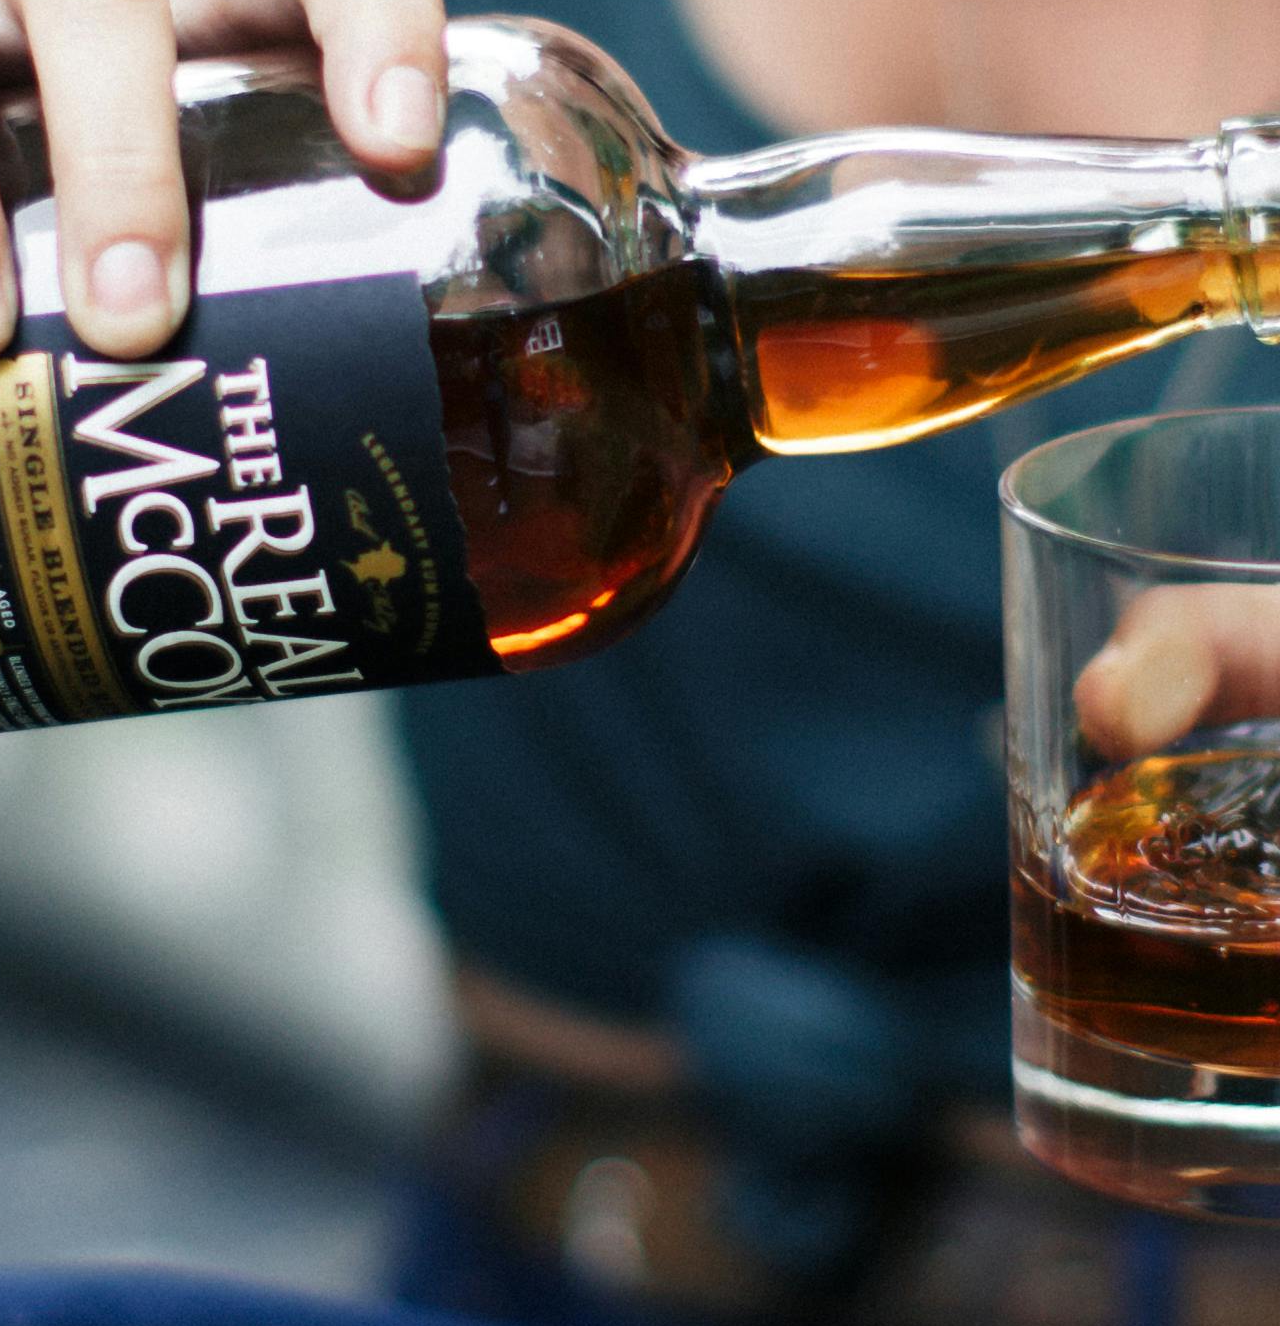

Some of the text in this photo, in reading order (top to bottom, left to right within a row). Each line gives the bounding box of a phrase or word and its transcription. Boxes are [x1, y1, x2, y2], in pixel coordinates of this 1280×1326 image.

[6, 439, 16, 459] NO
[10, 466, 26, 513] ADDED
[206, 356, 363, 694] THE REAL
[360, 432, 429, 548] LEGENDARY
[419, 557, 439, 595] RUM
[13, 381, 55, 531] SINGLE
[43, 548, 100, 687] BLENDED
